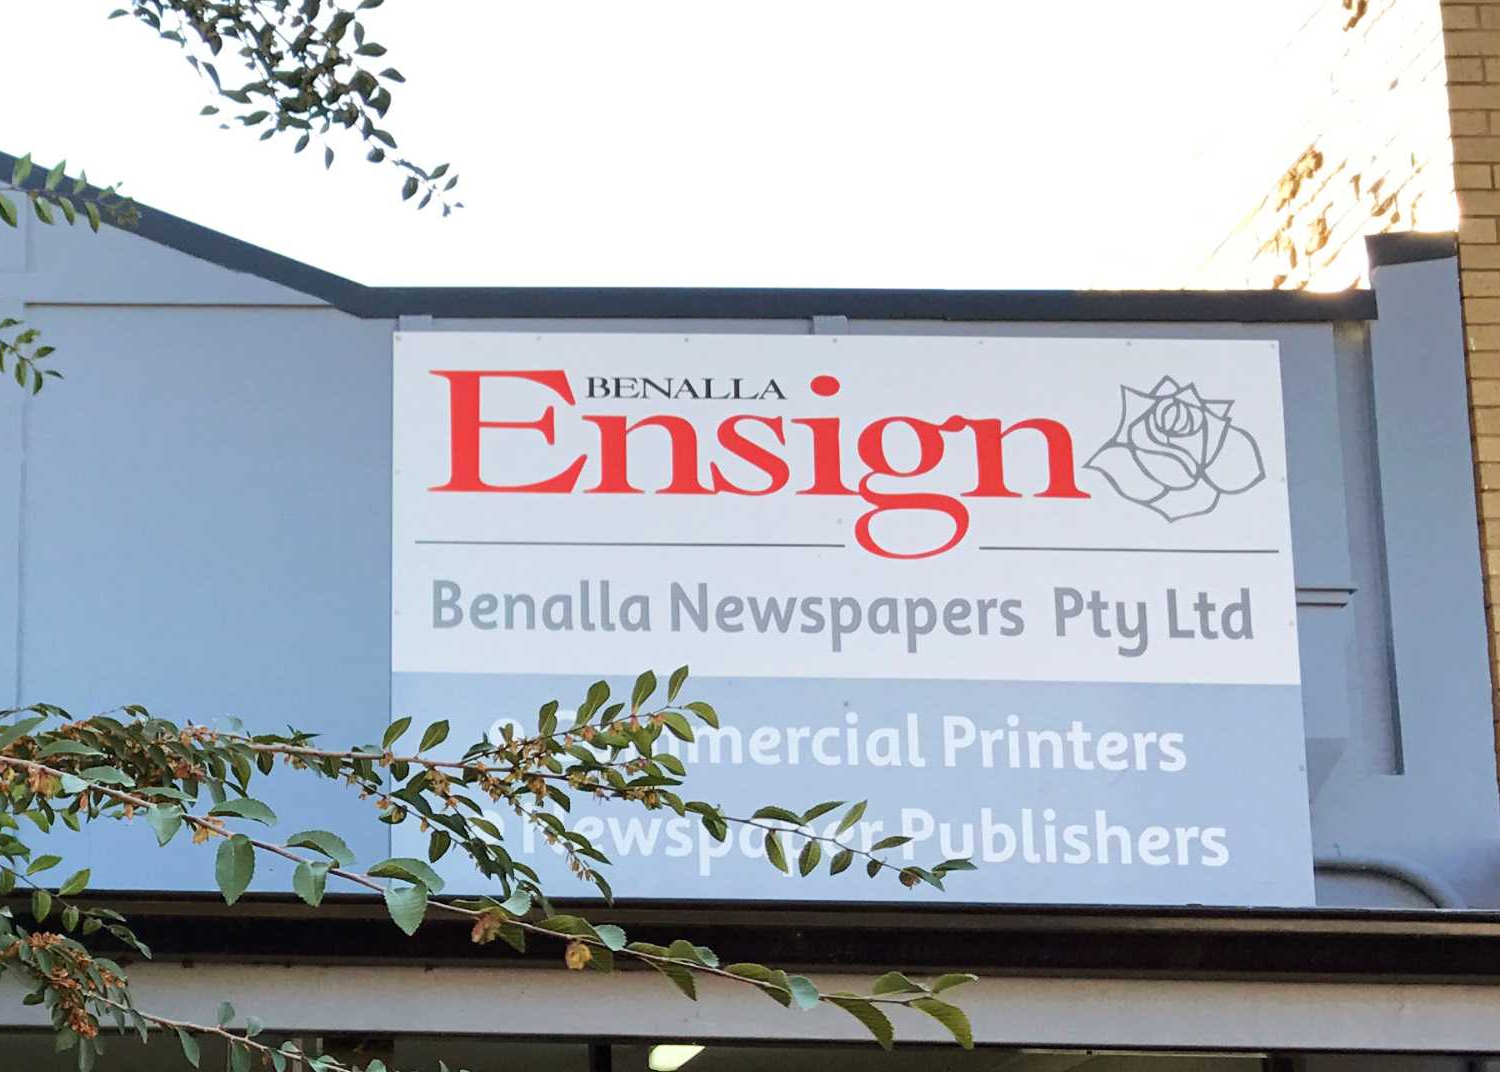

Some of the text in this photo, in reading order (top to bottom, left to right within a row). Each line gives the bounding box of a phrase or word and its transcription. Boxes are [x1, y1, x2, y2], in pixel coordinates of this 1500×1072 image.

[586, 376, 787, 401] BENALLA
[428, 369, 1091, 560] Ensign
[431, 579, 1255, 658] Benalla Newspapers Pty Ltd
[550, 709, 1188, 772] mercial Printers
[902, 808, 1230, 867] Publishers
